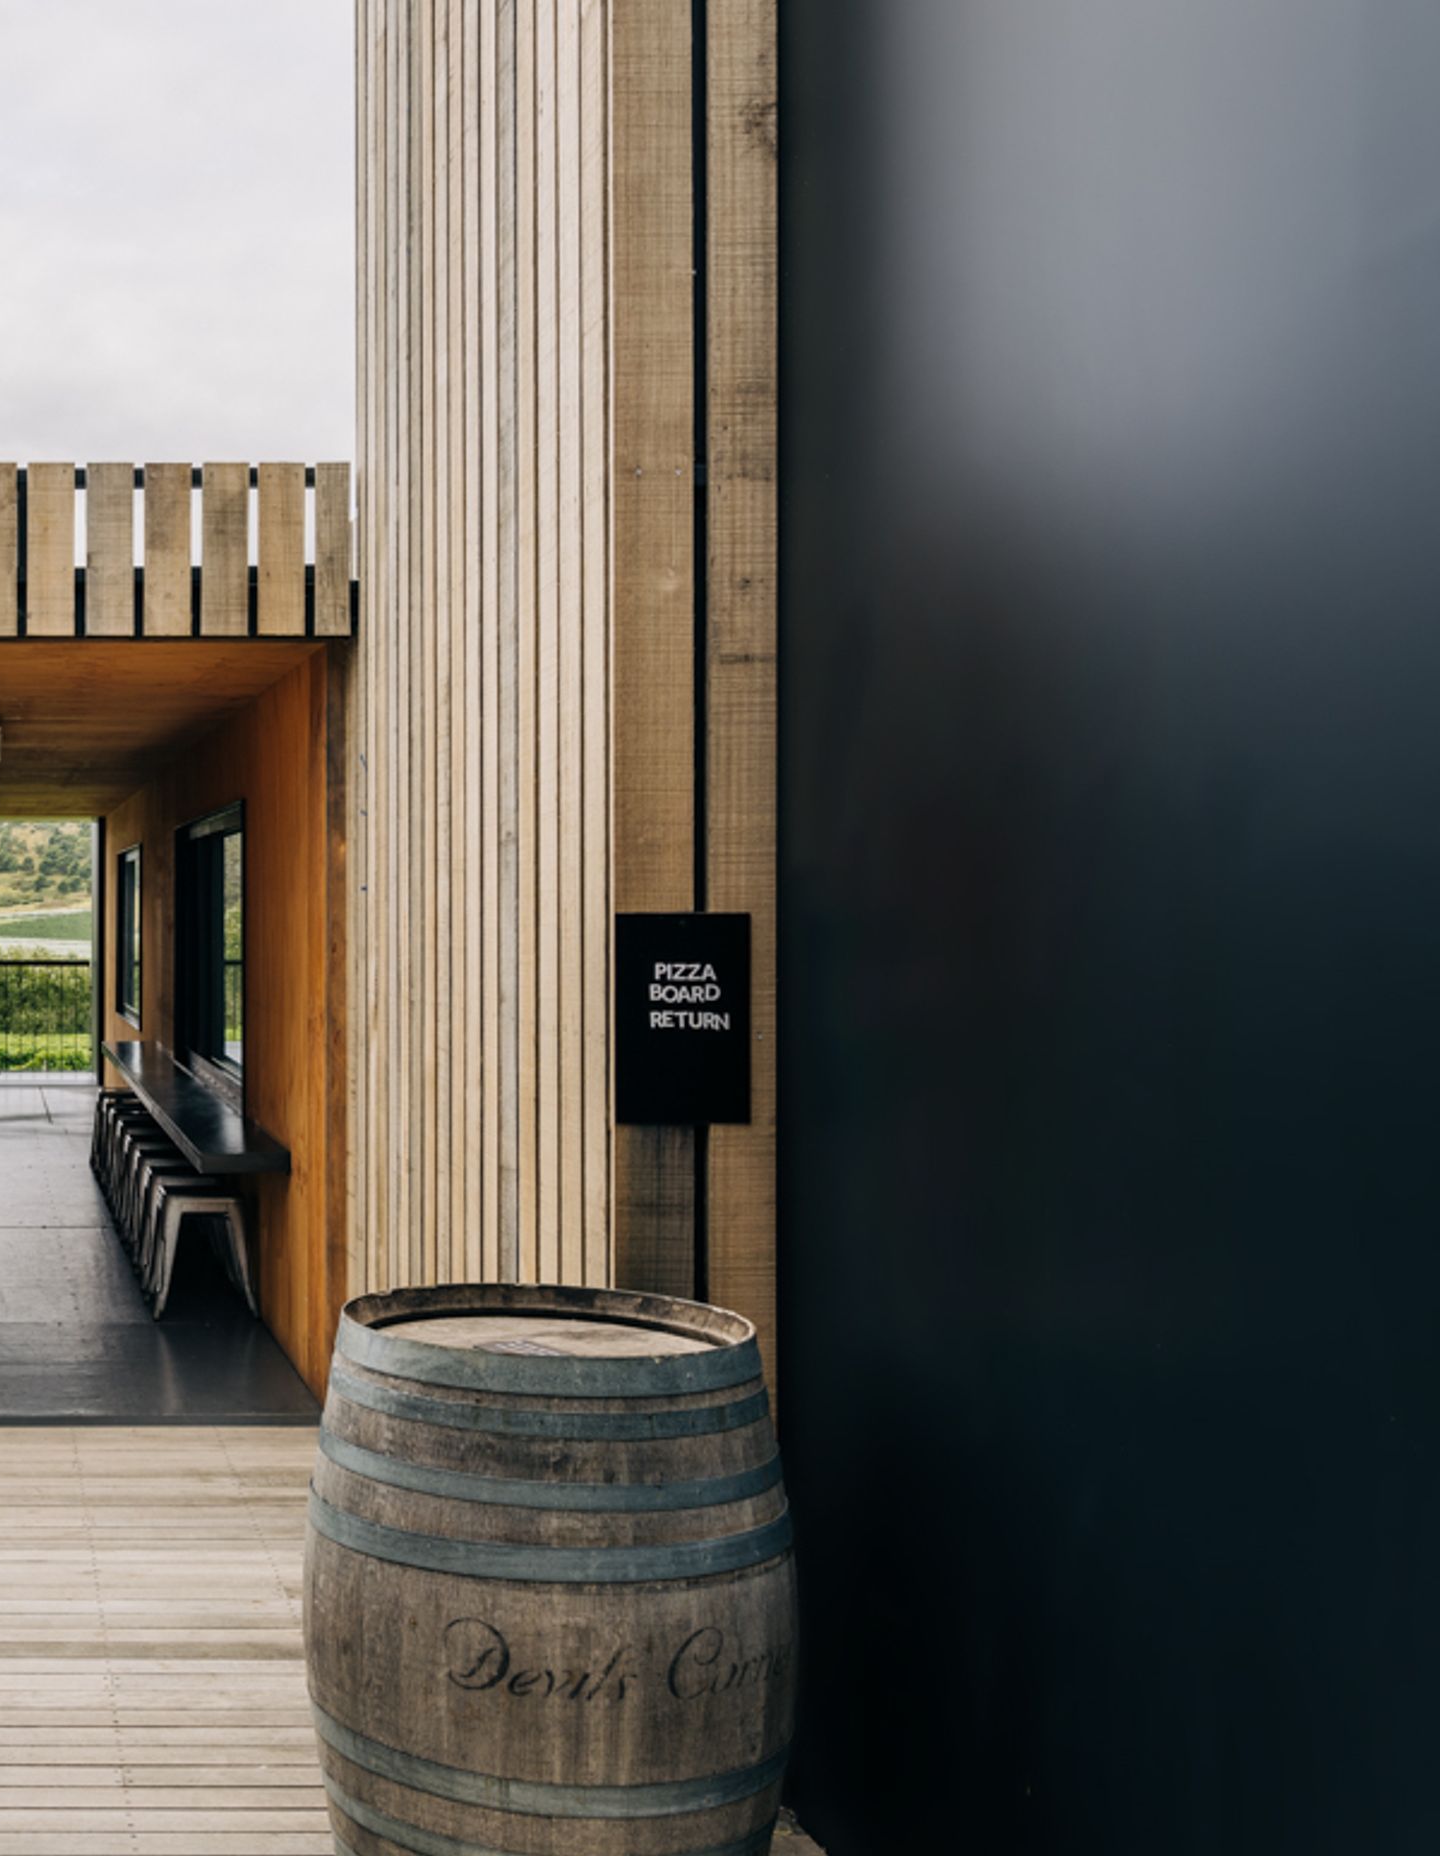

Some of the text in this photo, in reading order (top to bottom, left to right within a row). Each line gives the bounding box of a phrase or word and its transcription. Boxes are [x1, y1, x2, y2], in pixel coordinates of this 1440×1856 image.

[654, 962, 717, 982] PIZZA
[649, 983, 721, 1003] BOARD
[649, 1011, 731, 1031] RETURN
